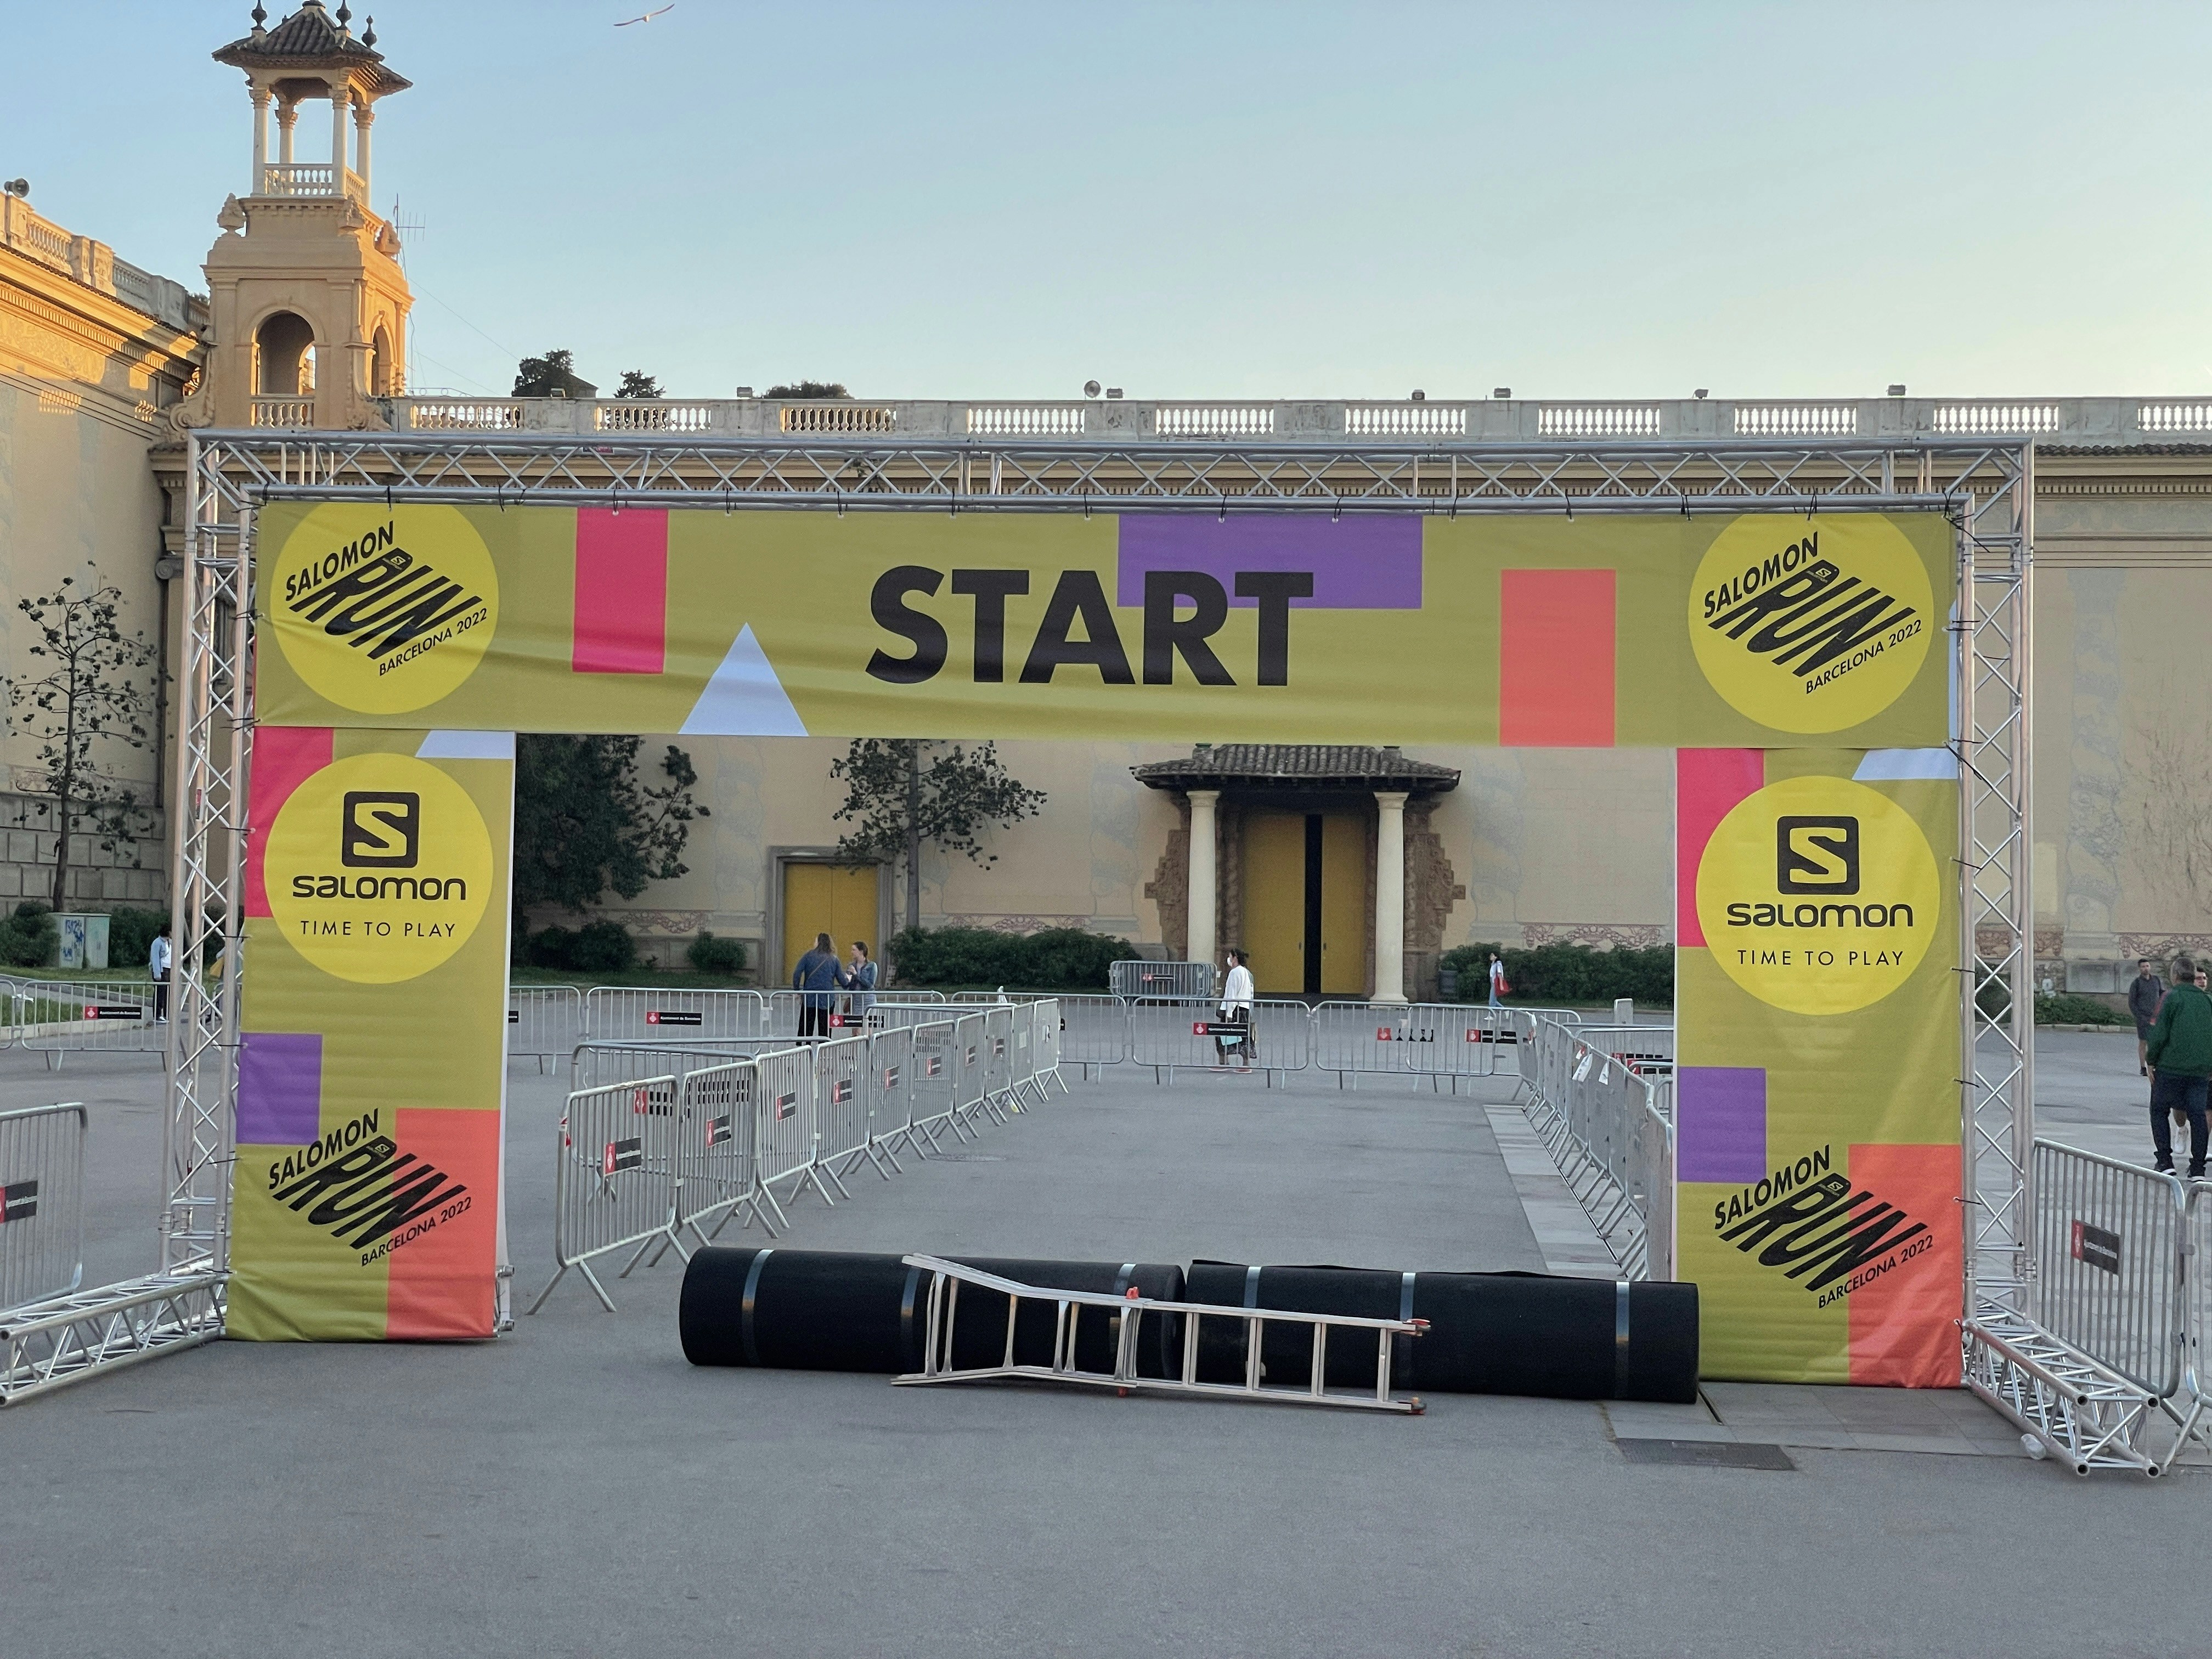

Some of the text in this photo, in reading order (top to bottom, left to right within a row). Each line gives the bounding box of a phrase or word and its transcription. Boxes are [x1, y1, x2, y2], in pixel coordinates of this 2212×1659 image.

[285, 521, 393, 601] SALOMON
[1704, 531, 1818, 618] SALOMON
[289, 548, 482, 659] RUN
[379, 608, 487, 676] BARCELONA 2022
[865, 565, 1314, 686] START
[1708, 559, 1916, 677] RUN
[1806, 620, 1922, 694] BARCELONA 2022
[292, 876, 466, 900] salomon
[1726, 903, 1913, 928] salomon
[301, 921, 456, 937] TIME TO PLAY
[1737, 950, 1904, 966] TIME TO PLAY
[268, 1108, 379, 1189] SALOMON
[1714, 1144, 1830, 1230] SALOMON
[272, 1135, 467, 1250] RUN
[361, 1197, 472, 1267] BARCELONA 2022
[1719, 1172, 1927, 1291] RUN
[1819, 1235, 1933, 1308] BARCELONA 2022
